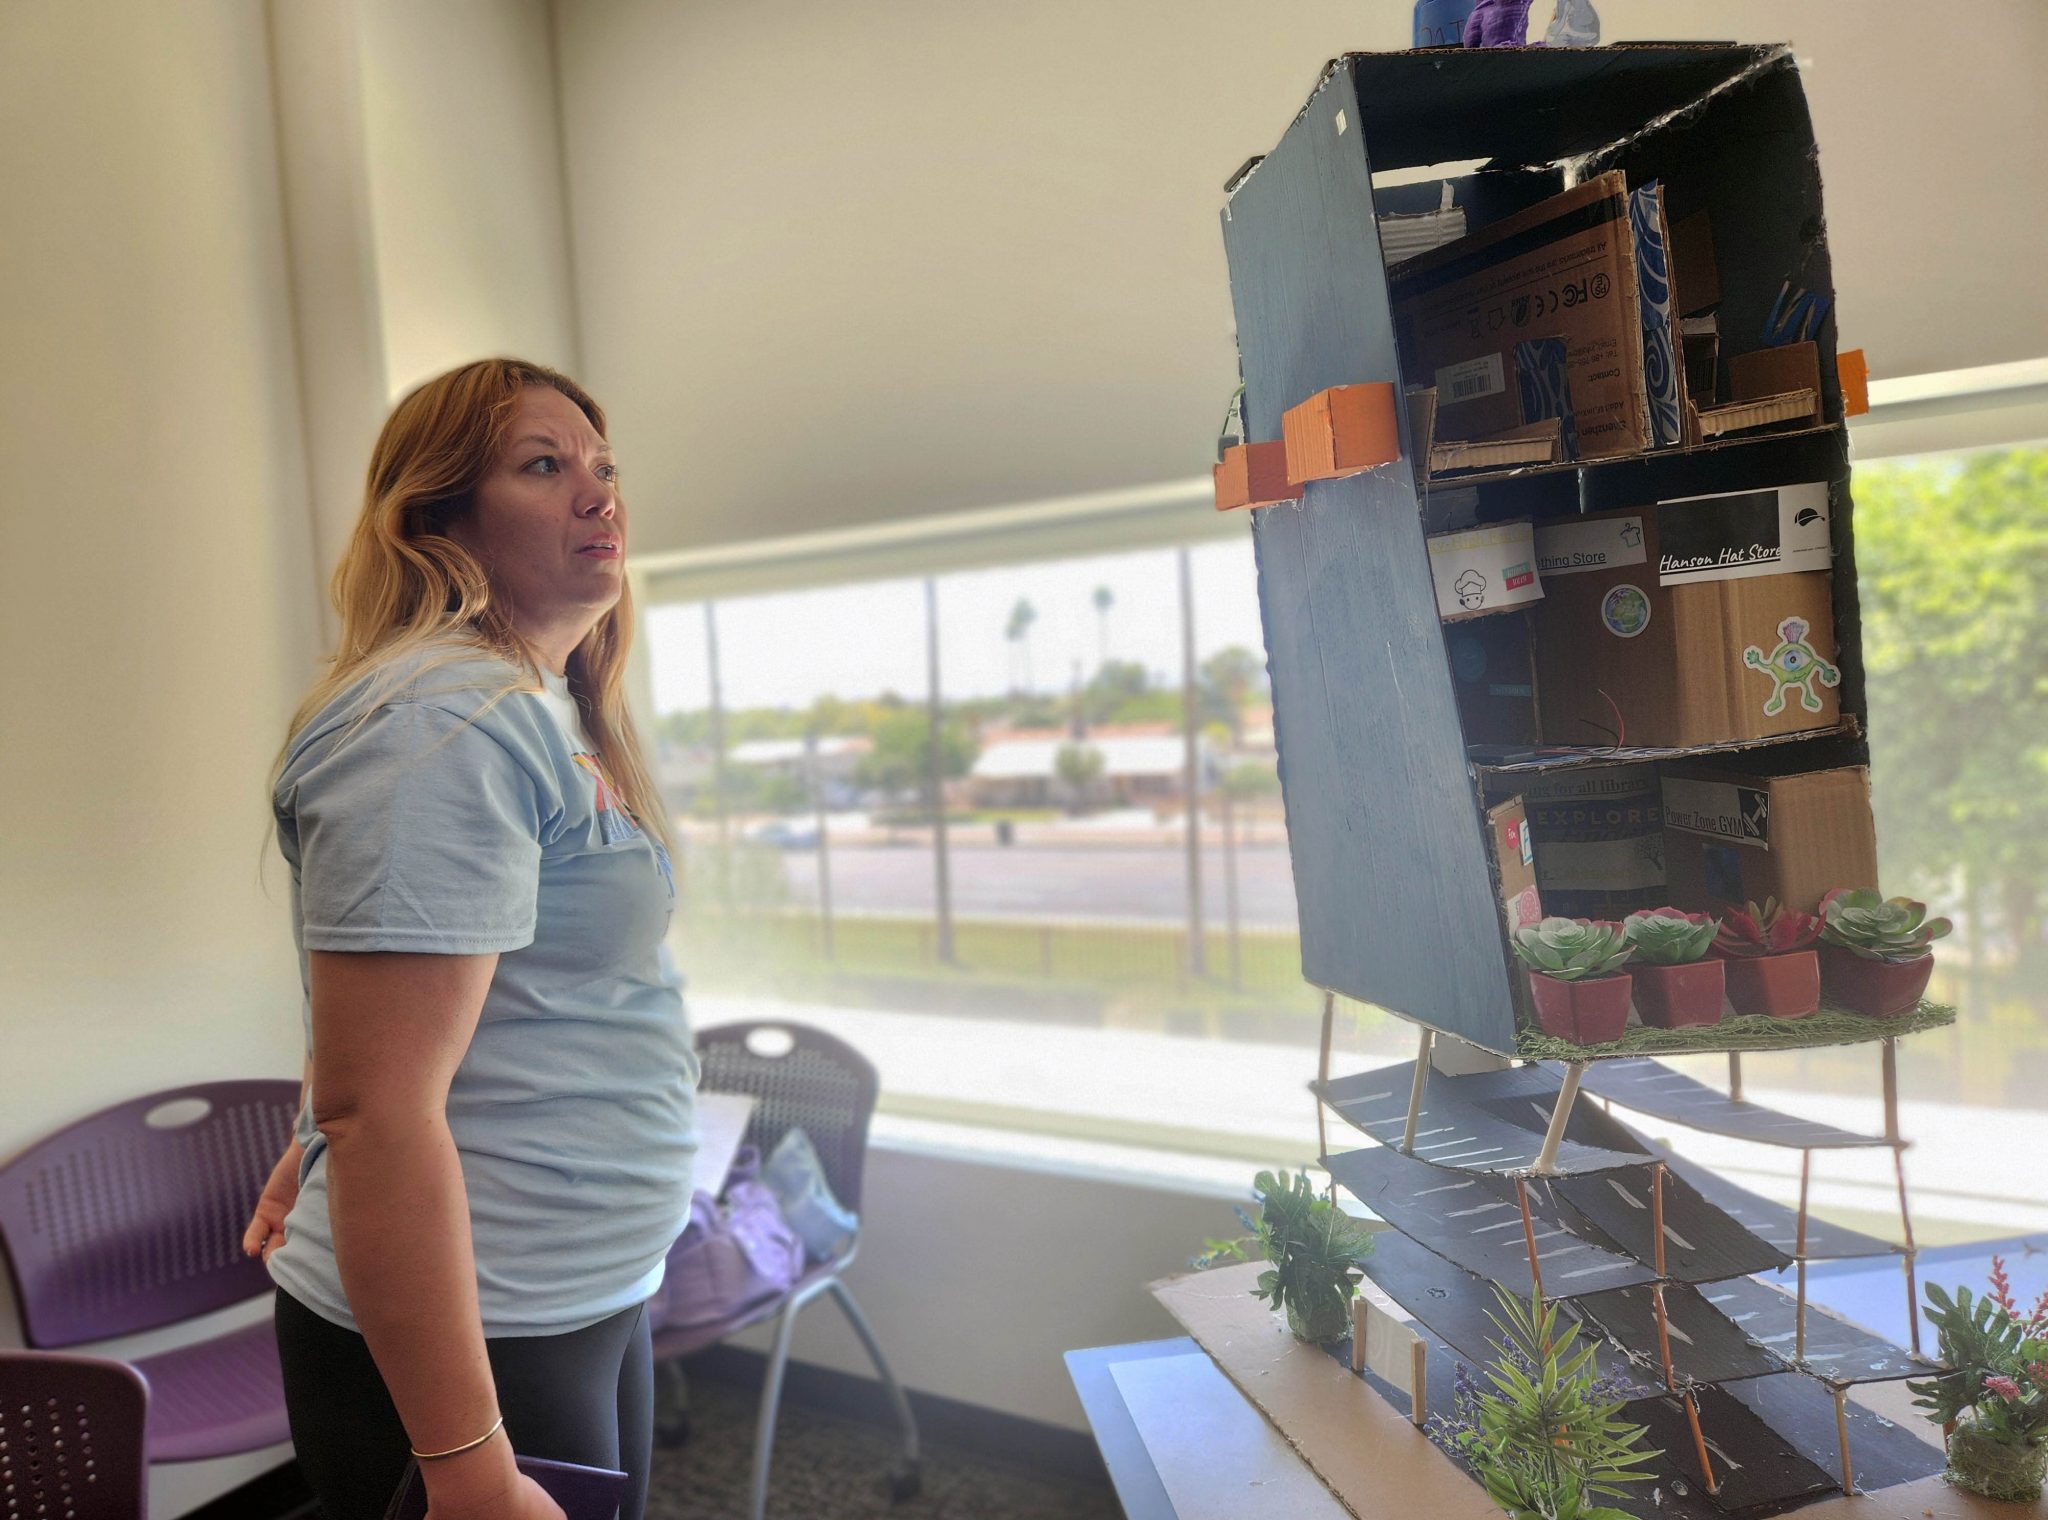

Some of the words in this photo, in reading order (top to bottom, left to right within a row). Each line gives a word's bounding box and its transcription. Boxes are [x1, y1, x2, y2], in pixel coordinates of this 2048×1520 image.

[1588, 367, 1620, 382] Contact:
[1573, 552, 1606, 564] Store
[1659, 553, 1713, 571] Hanson
[1718, 547, 1744, 565] Hat
[1749, 543, 1782, 560] Store
[1537, 807, 1660, 825] EXPLORE
[1665, 806, 1692, 826] Power
[1694, 811, 1717, 831] Zone
[1719, 815, 1744, 836] GYM
